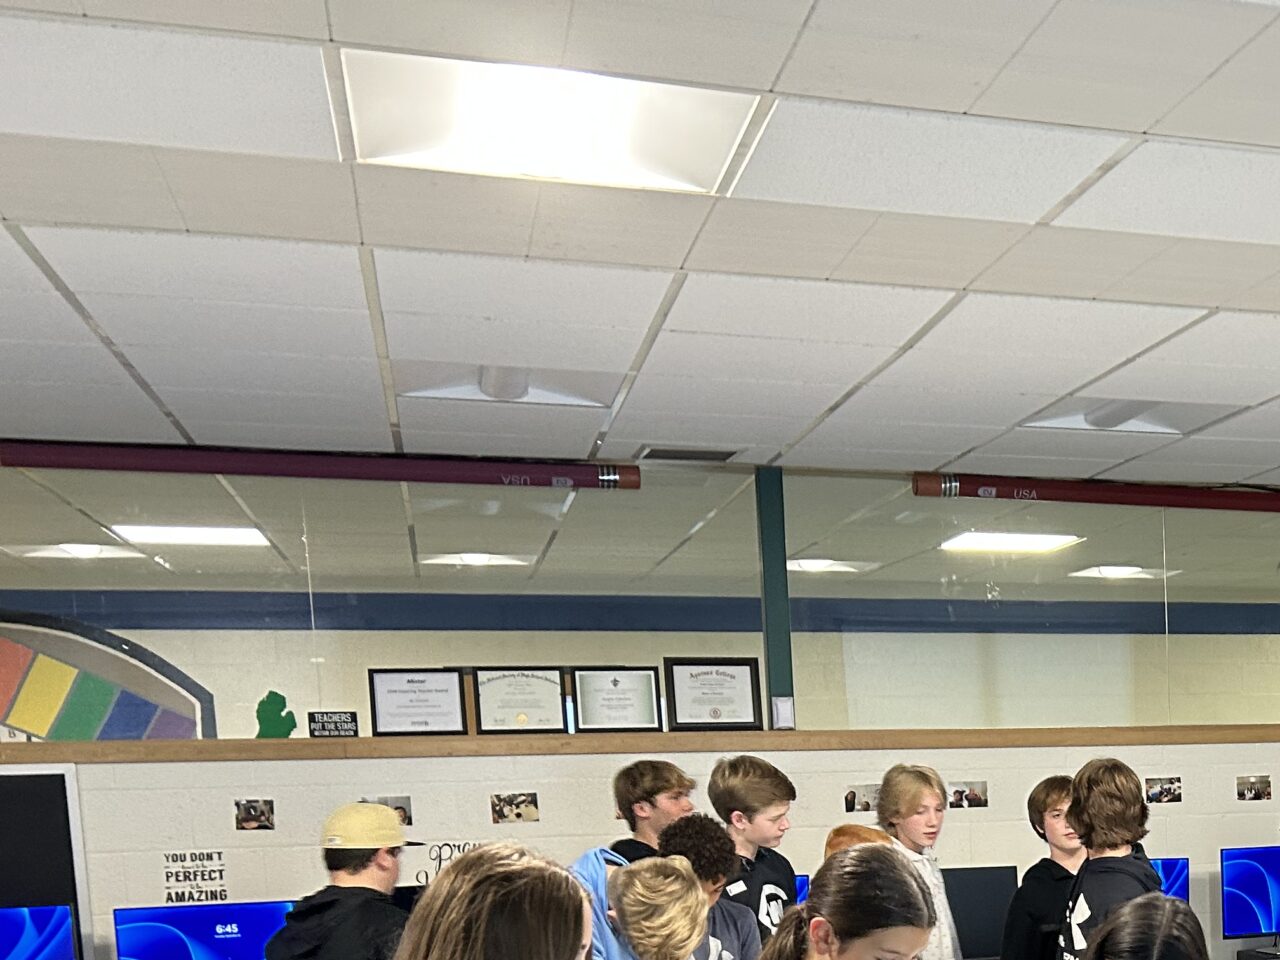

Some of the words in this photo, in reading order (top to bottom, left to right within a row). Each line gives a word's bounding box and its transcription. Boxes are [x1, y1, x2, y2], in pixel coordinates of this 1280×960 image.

[1013, 488, 1037, 499] USA
[314, 713, 352, 722] TEACHERS
[311, 722, 323, 730] PUT
[324, 722, 336, 730] THE
[336, 722, 357, 730] STARS
[163, 853, 187, 863] YOU
[190, 851, 223, 862] DON'T
[165, 868, 226, 883] PERFECT
[166, 889, 228, 904] AMAZING
[216, 924, 239, 934] 6:45
